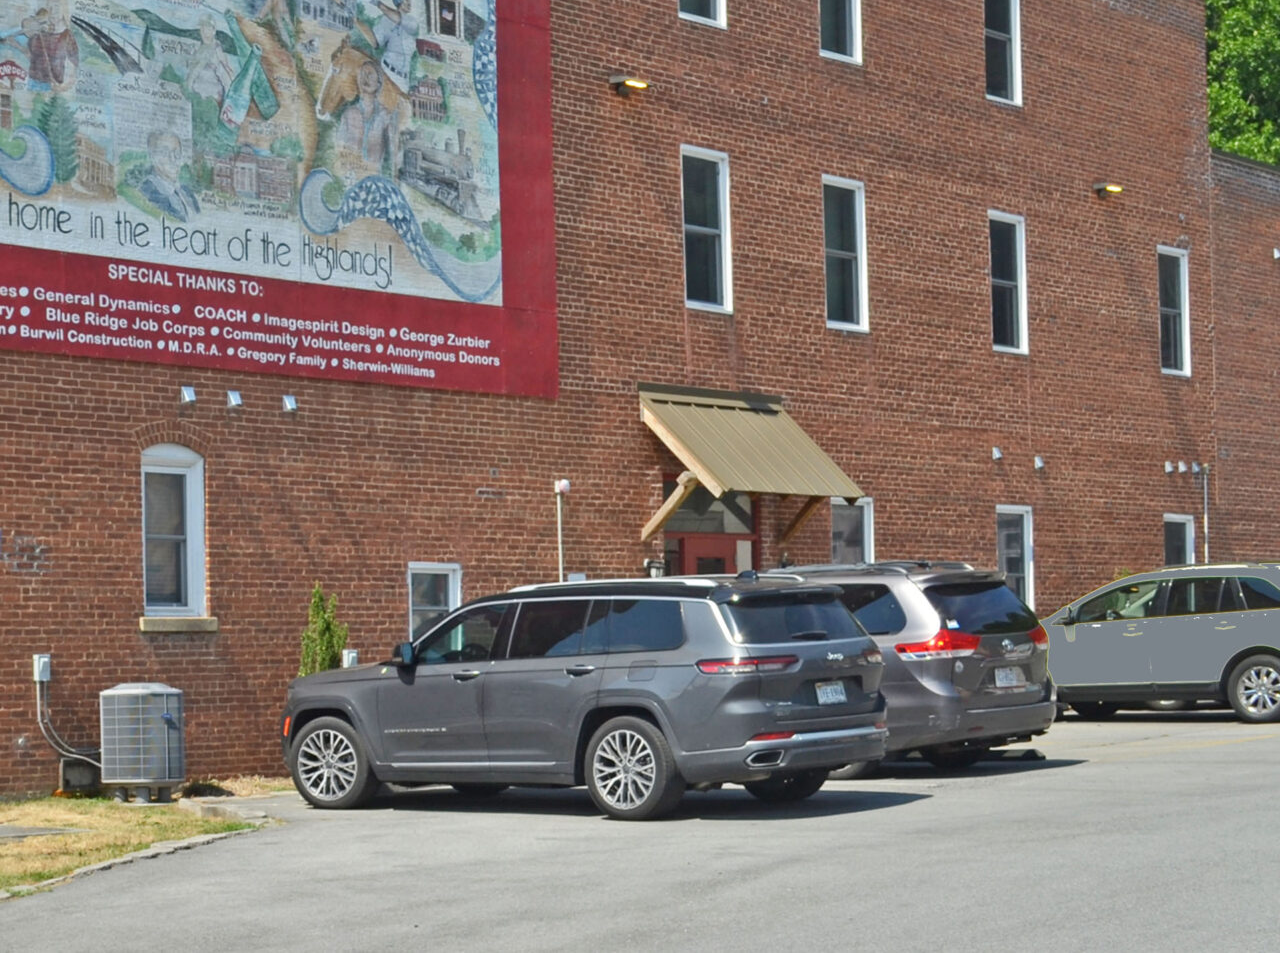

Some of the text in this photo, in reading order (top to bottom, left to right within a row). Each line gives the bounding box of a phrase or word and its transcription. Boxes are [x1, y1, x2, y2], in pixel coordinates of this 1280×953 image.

[8, 192, 74, 235] home
[89, 211, 106, 240] in
[114, 210, 150, 248] the
[161, 215, 219, 257] heart
[227, 228, 253, 262] of
[261, 232, 292, 267] the
[301, 234, 393, 289] Highlands!
[108, 263, 264, 297] SPECIAL THANKS TO:
[33, 286, 95, 307] General
[98, 294, 171, 315] Dynamics
[193, 305, 247, 323] COACH
[263, 312, 340, 334] Imagespirit
[341, 321, 385, 341] Design
[399, 326, 445, 347] George
[446, 333, 491, 349] Zurbier
[45, 306, 81, 324] Blue
[84, 311, 128, 331] Ridge
[131, 317, 159, 332] Job
[162, 319, 206, 338] Corps
[222, 326, 299, 352] Community
[301, 334, 372, 354] Volunteers
[386, 343, 456, 363] Anonymous
[458, 350, 501, 367] Donors
[19, 324, 64, 341] Burwil
[67, 329, 153, 350] Construction
[168, 339, 222, 356] M.D.R.A.
[237, 346, 287, 366] Gregory
[288, 351, 327, 370] Family
[342, 357, 436, 379] Sherwin-Williams
